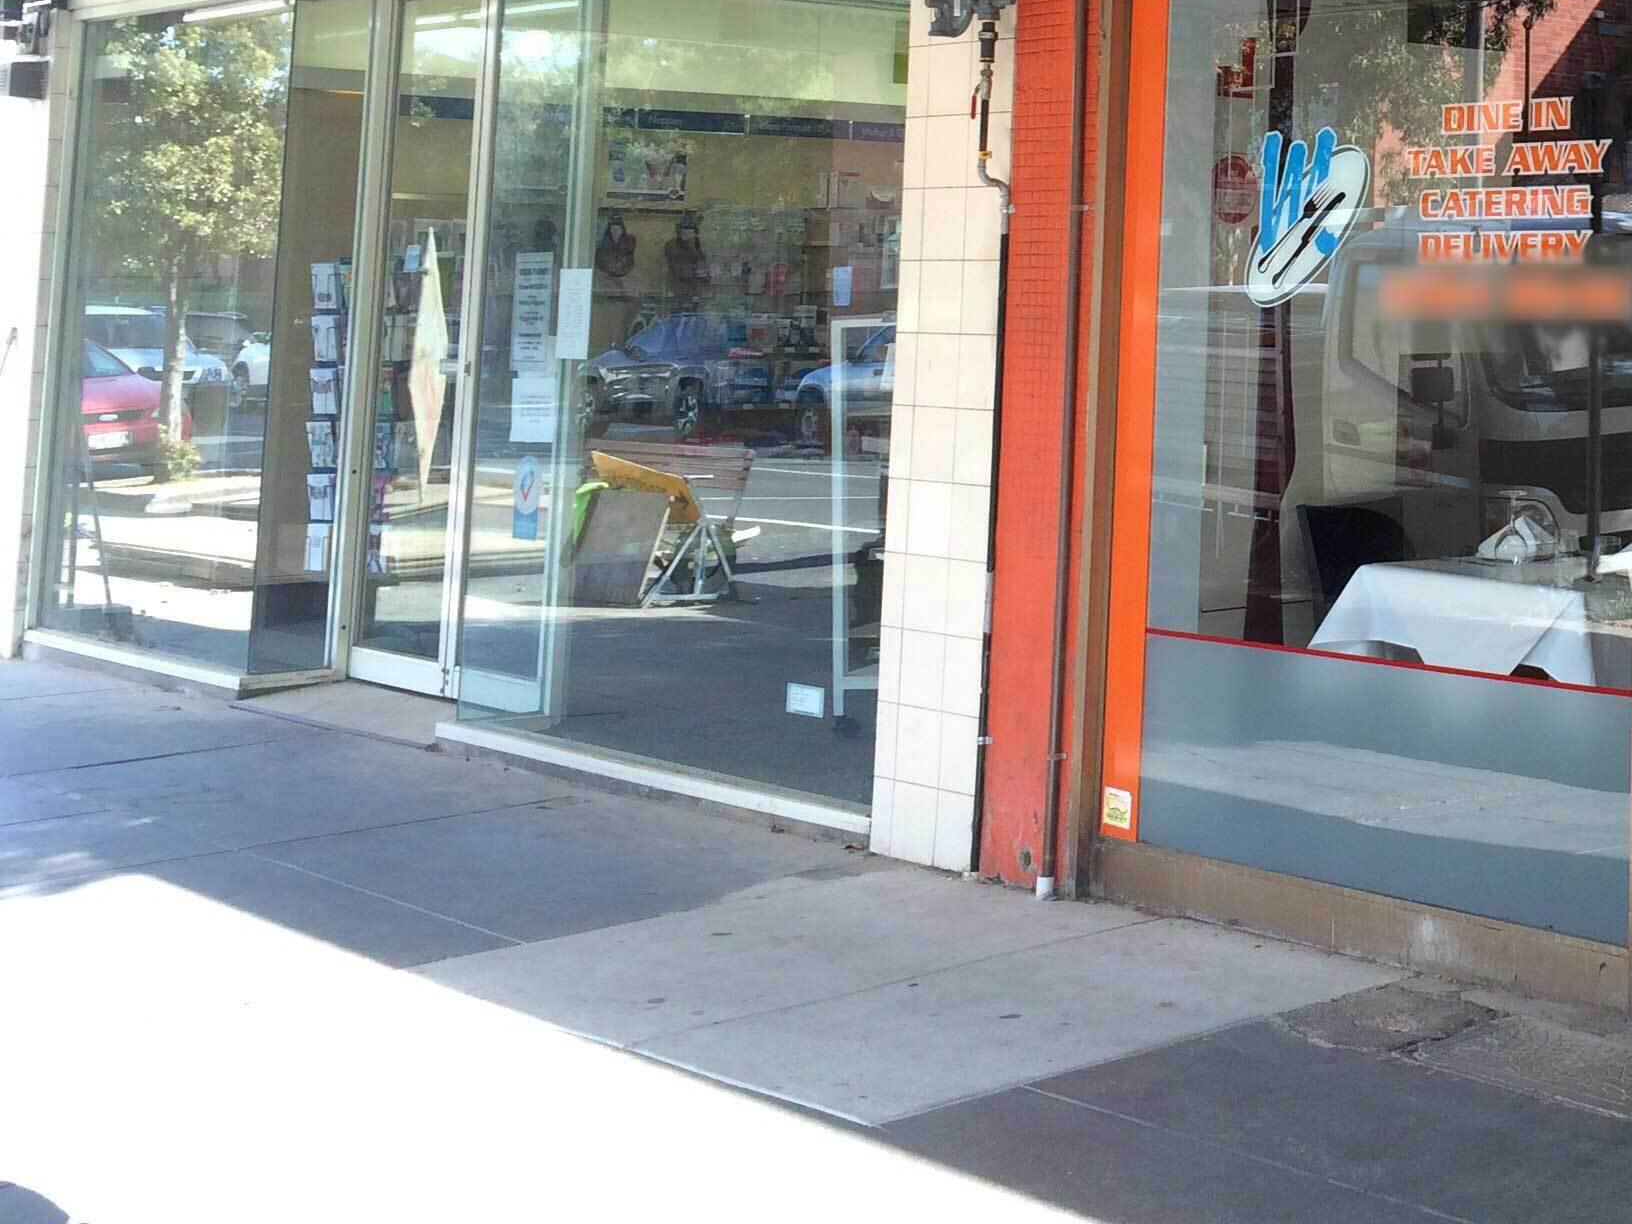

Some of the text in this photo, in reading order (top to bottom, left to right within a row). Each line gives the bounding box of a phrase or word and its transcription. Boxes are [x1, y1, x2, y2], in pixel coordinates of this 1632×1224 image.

[1441, 96, 1573, 134] DINE IN
[1407, 139, 1613, 178] TAKE AWAY
[1419, 185, 1594, 220] CATERING
[1418, 230, 1593, 264] DELIVERY
